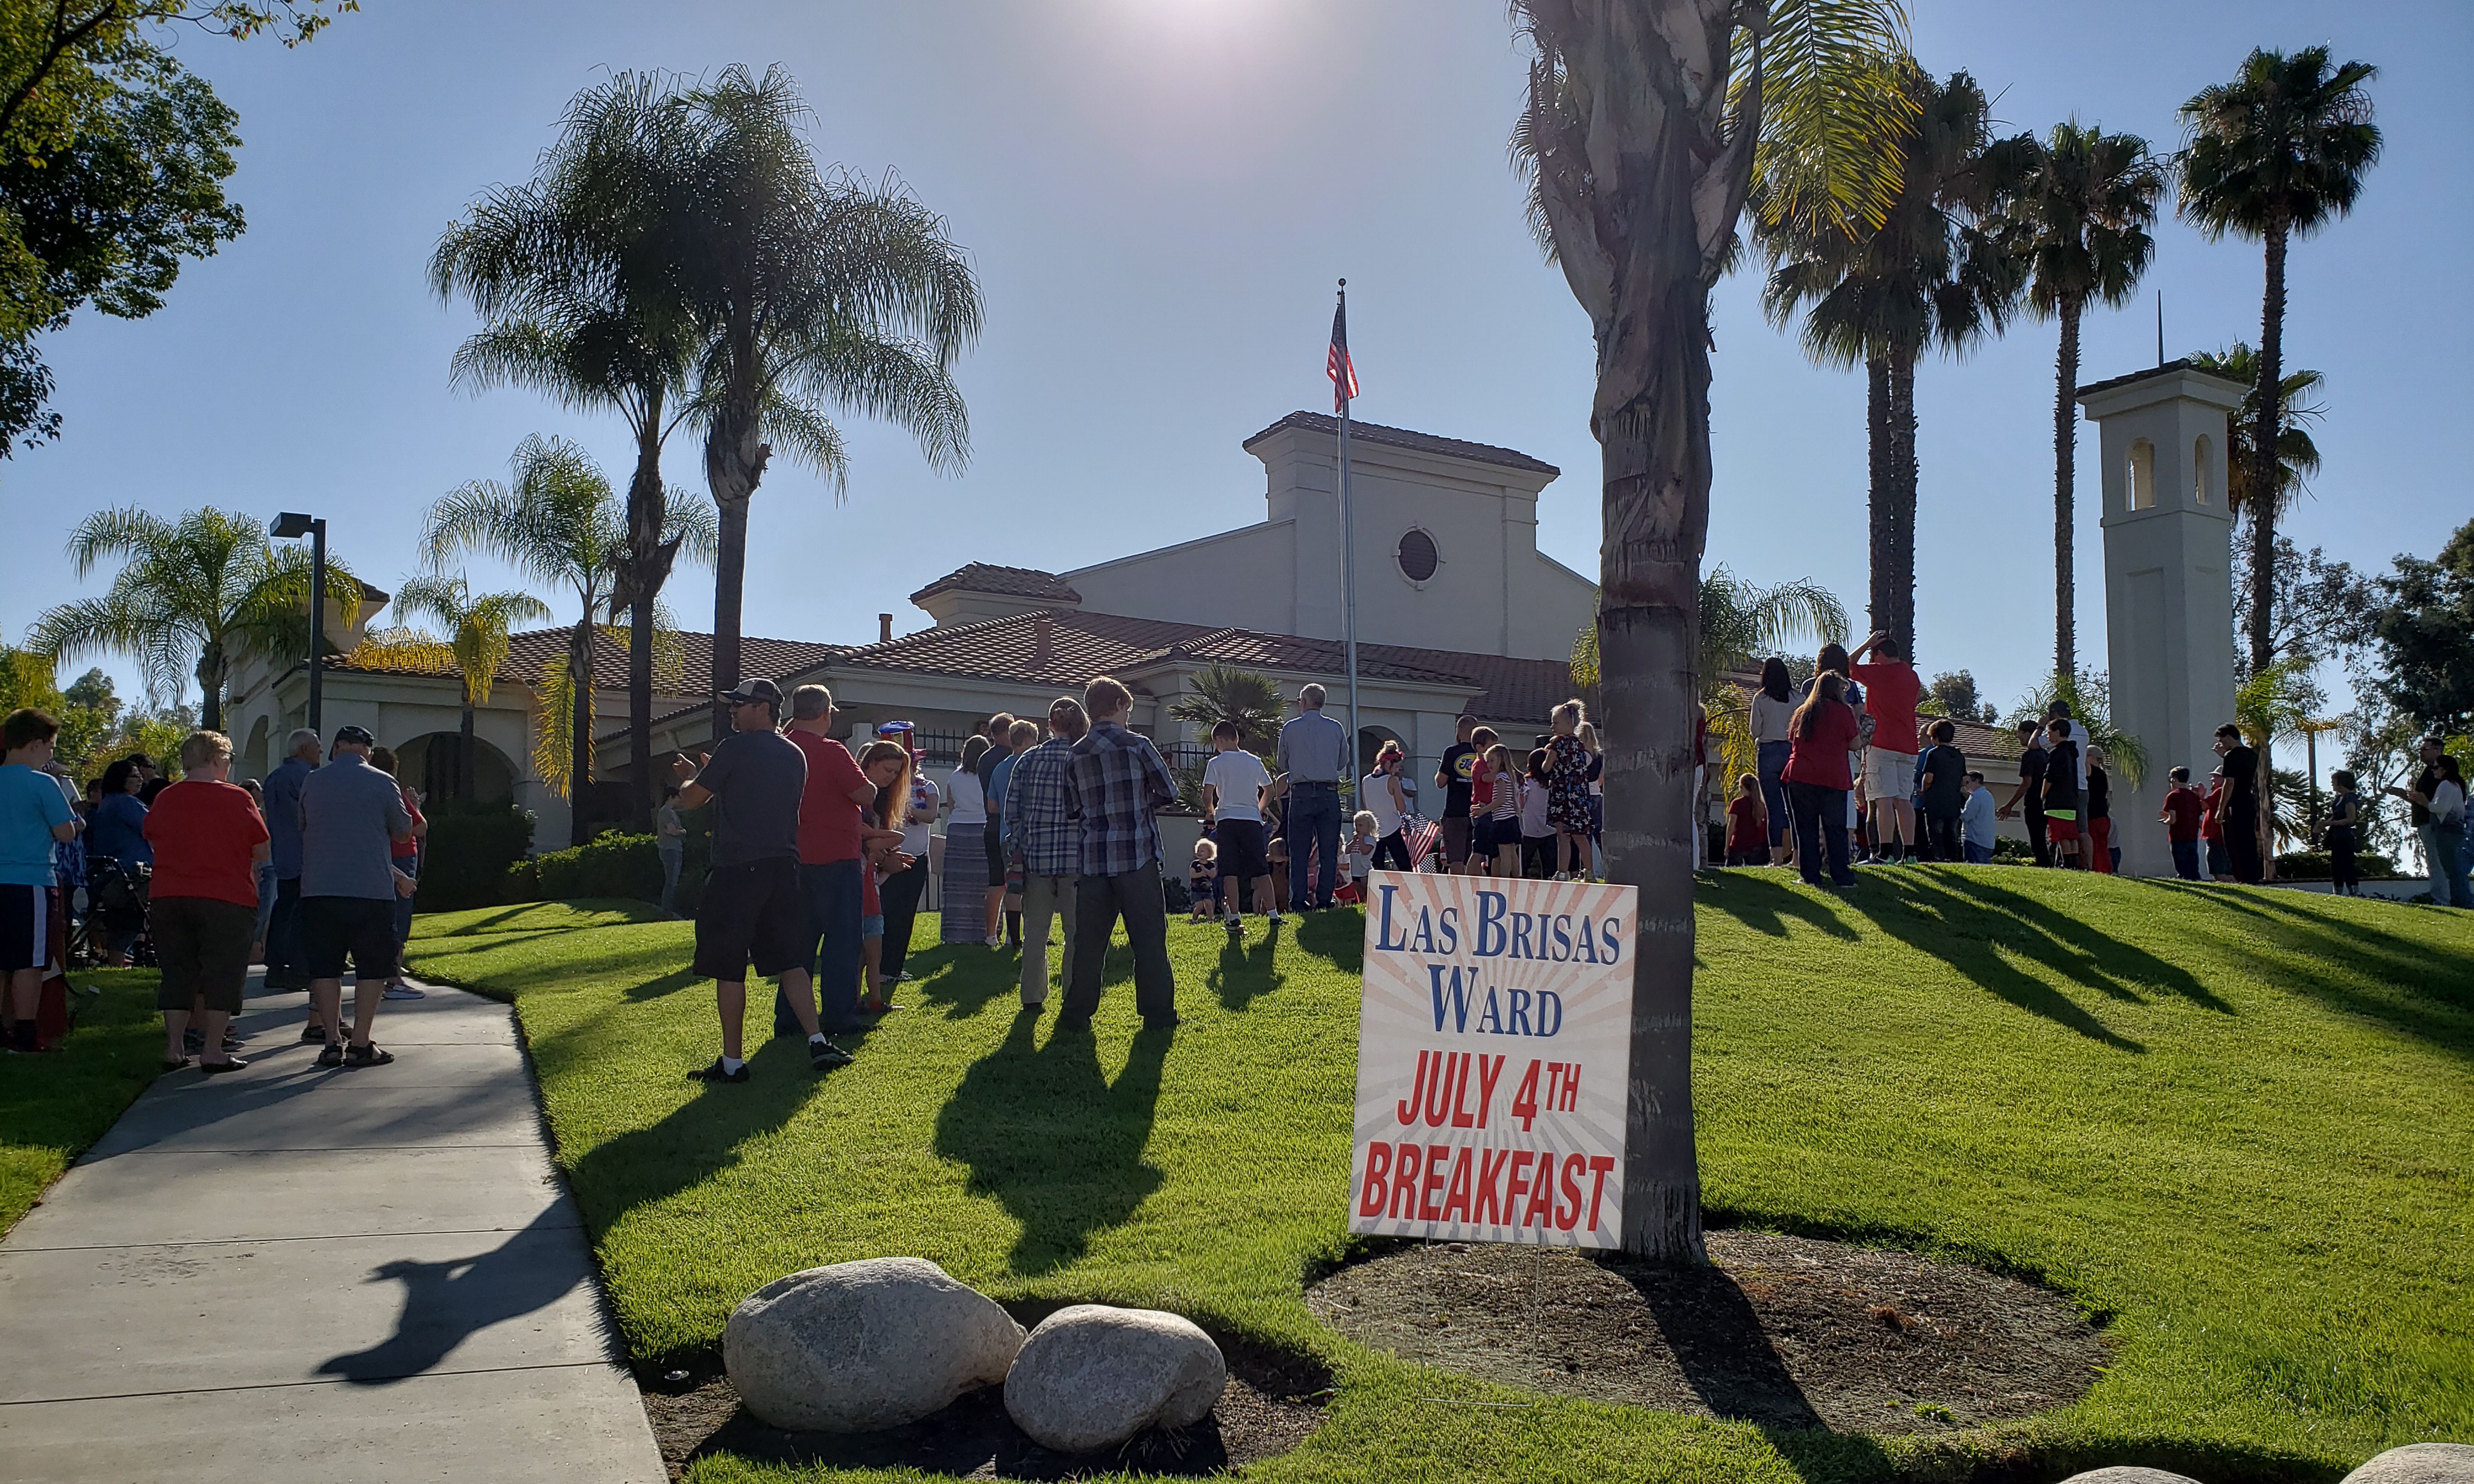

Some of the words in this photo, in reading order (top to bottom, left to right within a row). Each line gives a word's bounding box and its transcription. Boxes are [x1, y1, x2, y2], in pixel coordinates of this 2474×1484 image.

[1375, 884, 1458, 955] LAS
[1472, 890, 1620, 965] BRISAS
[1428, 964, 1562, 1037] WARD
[1397, 1050, 1505, 1129] JULY
[1512, 1059, 1582, 1132] 4TH
[1358, 1141, 1615, 1232] BREAKFAST
